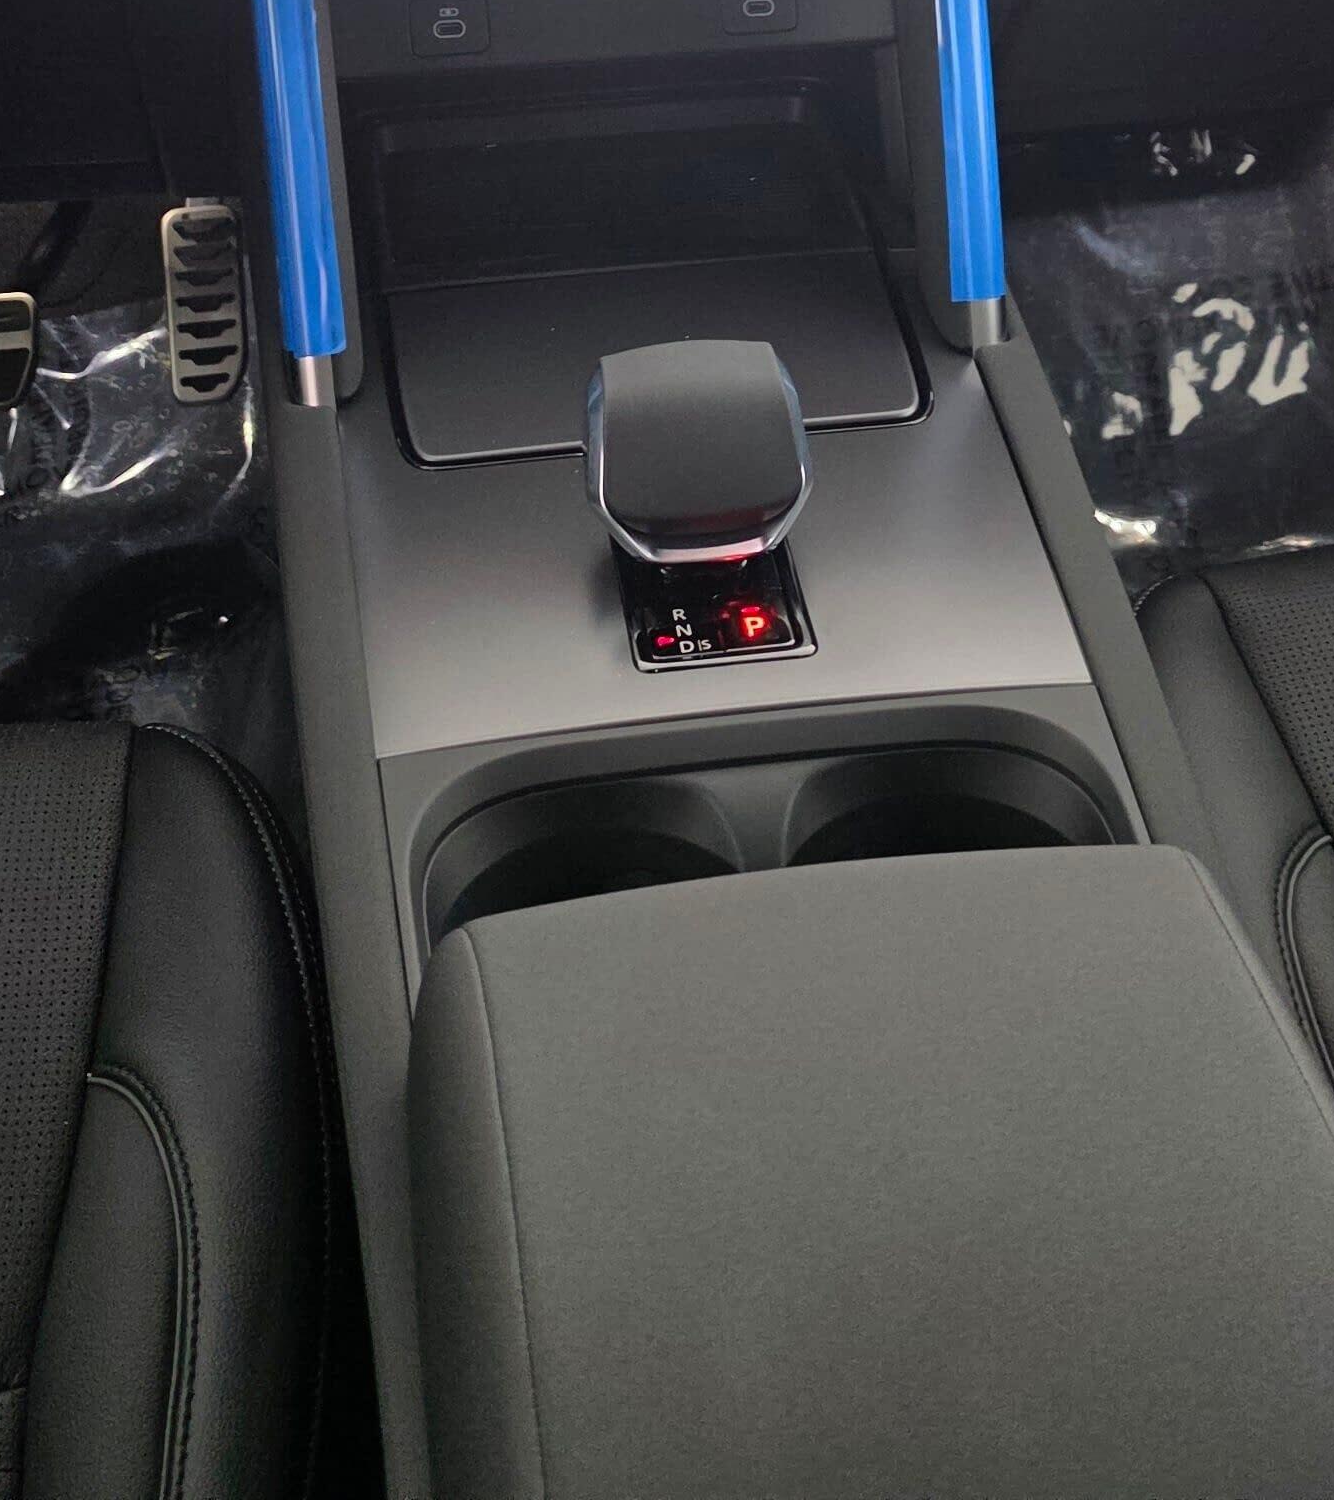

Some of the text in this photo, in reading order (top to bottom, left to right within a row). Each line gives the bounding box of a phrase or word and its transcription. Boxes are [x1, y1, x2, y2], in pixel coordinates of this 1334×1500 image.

[672, 608, 687, 622] R
[675, 623, 693, 637] N
[743, 616, 766, 638] P
[679, 639, 695, 654] D
